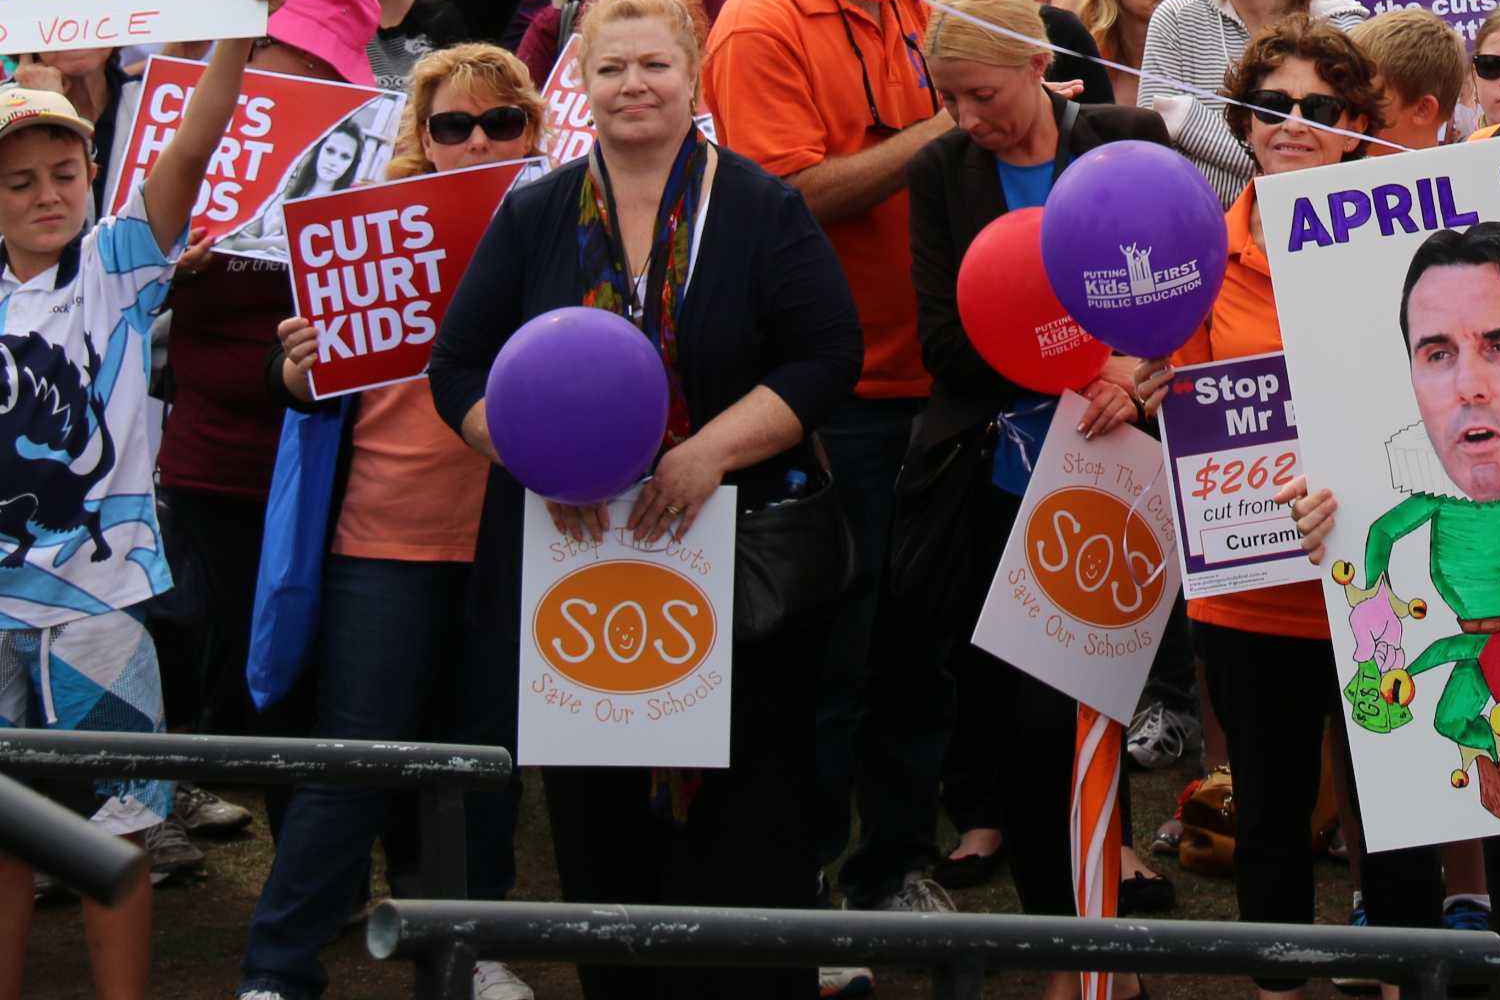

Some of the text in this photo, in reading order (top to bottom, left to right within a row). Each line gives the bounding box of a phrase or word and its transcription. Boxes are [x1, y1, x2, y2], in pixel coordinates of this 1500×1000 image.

[38, 10, 161, 44] VOICE
[150, 83, 275, 137] CS
[136, 125, 274, 181] HRT
[299, 204, 435, 267] CUTS
[1287, 176, 1480, 252] APRIL
[306, 248, 447, 316] HURT
[1083, 268, 1128, 280] PUTTING
[1085, 280, 1130, 296] Kids
[1088, 278, 1203, 309] PUBLIC EDUCATION
[1153, 259, 1199, 284] FIRST
[314, 300, 437, 363] KIDS
[1037, 323, 1078, 348] Kids
[1041, 339, 1081, 359] PUBLIC
[1195, 373, 1280, 405] Stop
[1225, 406, 1272, 436] Mr
[1063, 452, 1176, 542] Stop The Cuts
[1191, 451, 1297, 500] $262
[1203, 503, 1232, 522] cut
[550, 534, 603, 562] Stop
[1037, 510, 1155, 613] SOS
[552, 598, 698, 664] SOS
[1008, 567, 1152, 658] Save Our Schools
[532, 670, 723, 724] Save Our Schools
